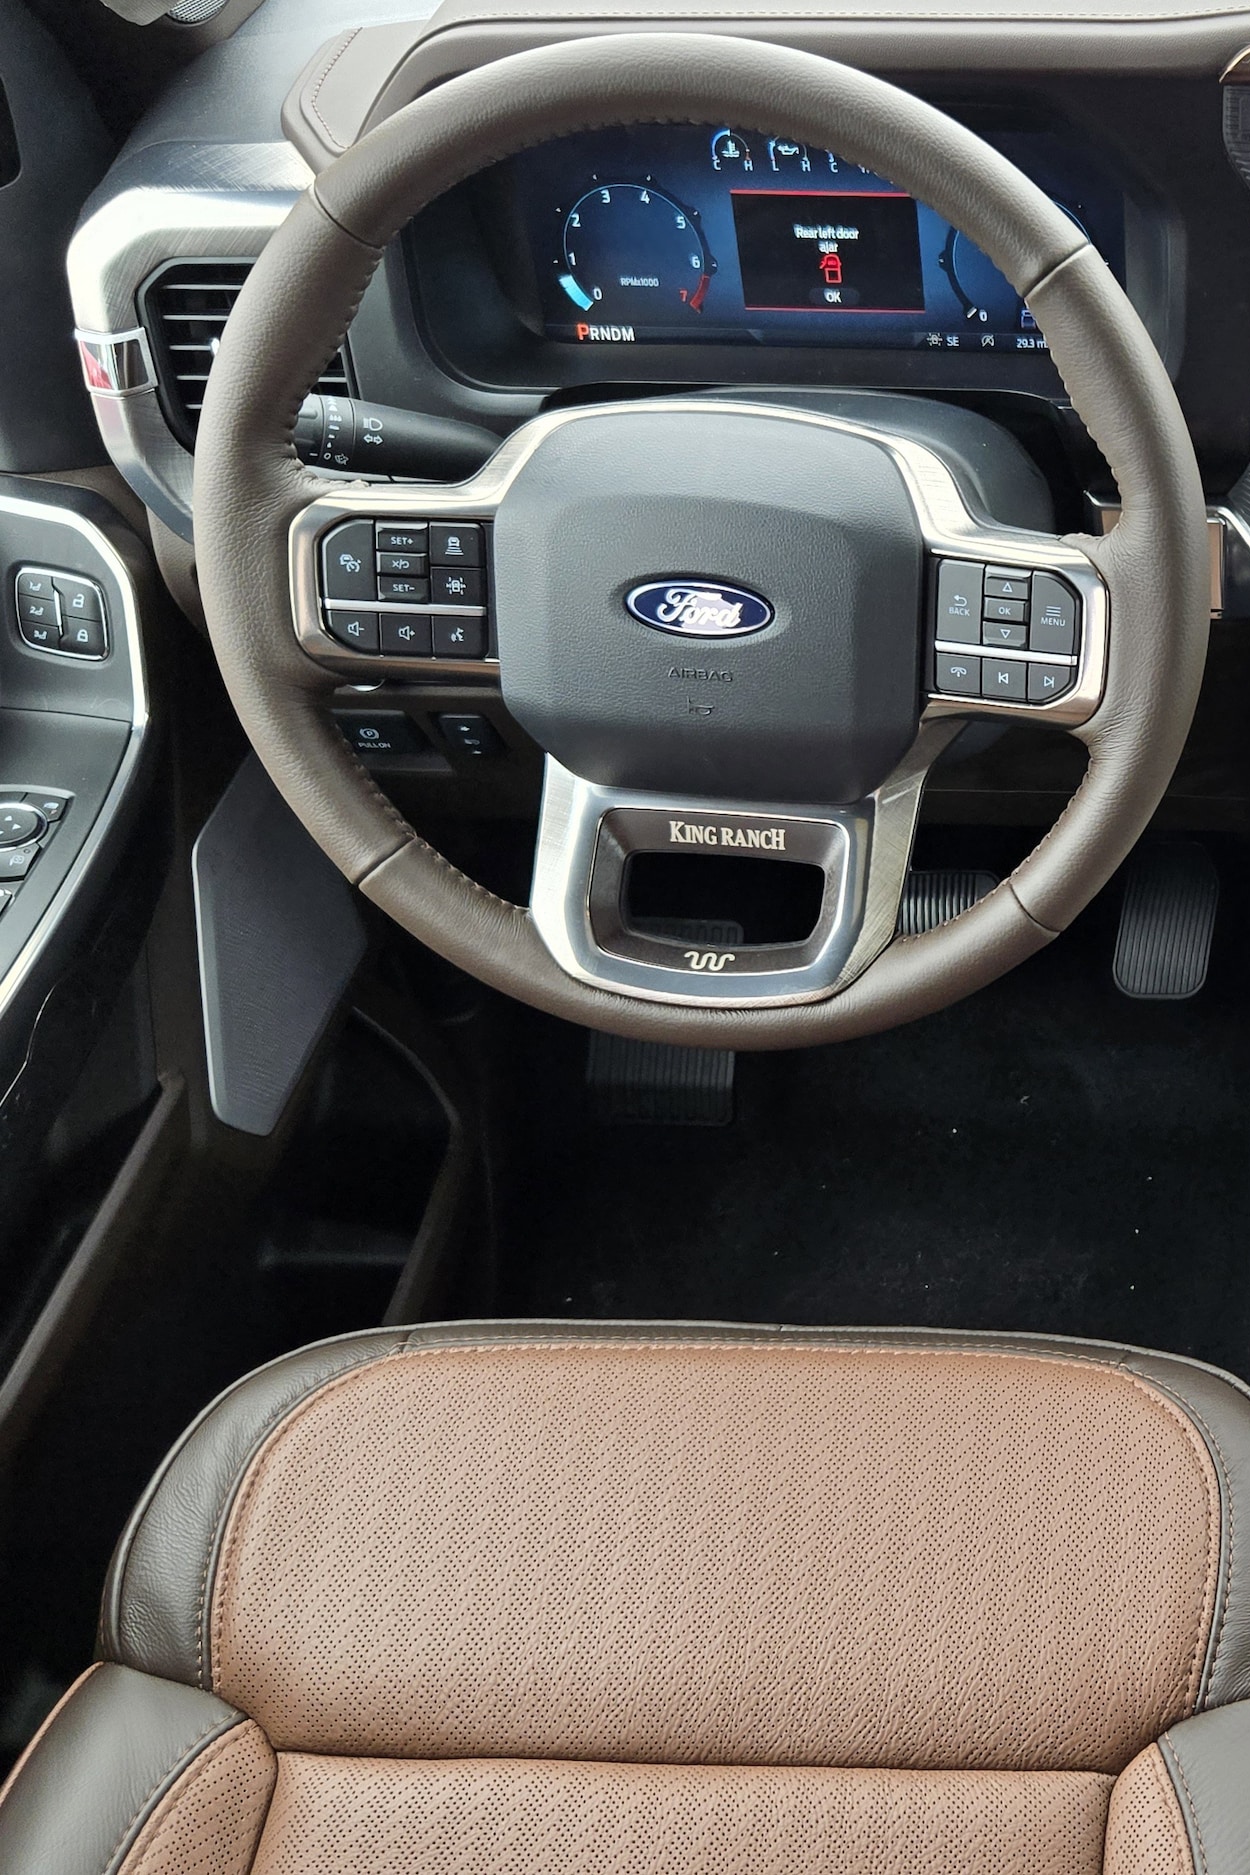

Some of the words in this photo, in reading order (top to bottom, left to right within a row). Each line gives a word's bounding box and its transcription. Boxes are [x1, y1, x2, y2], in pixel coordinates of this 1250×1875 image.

[714, 160, 721, 171] C
[744, 160, 753, 171] H
[772, 160, 780, 171] L
[801, 160, 811, 171] H
[830, 162, 838, 173] C
[601, 189, 610, 203] 3
[640, 190, 650, 204] 4
[571, 213, 581, 227] 2
[676, 216, 686, 229] 5
[795, 225, 818, 239] Rear
[819, 225, 835, 239] left
[836, 226, 859, 240] door
[819, 241, 839, 254] ajar
[569, 252, 577, 265] 1
[691, 255, 700, 268] 6
[620, 277, 660, 287] RPMx1000
[593, 288, 602, 300] 0
[679, 289, 688, 302] 7
[825, 290, 841, 303] OK
[979, 311, 988, 322] 0
[947, 336, 959, 347] SE
[1016, 338, 1034, 349] 29.3
[390, 537, 414, 545] SET+
[656, 588, 743, 628] Ford
[949, 607, 970, 617] BACK
[998, 607, 1011, 616] OK
[1041, 617, 1066, 627] MENU
[668, 666, 734, 683] AIRBAG
[669, 820, 718, 845] KING
[720, 827, 786, 850] RANCH
